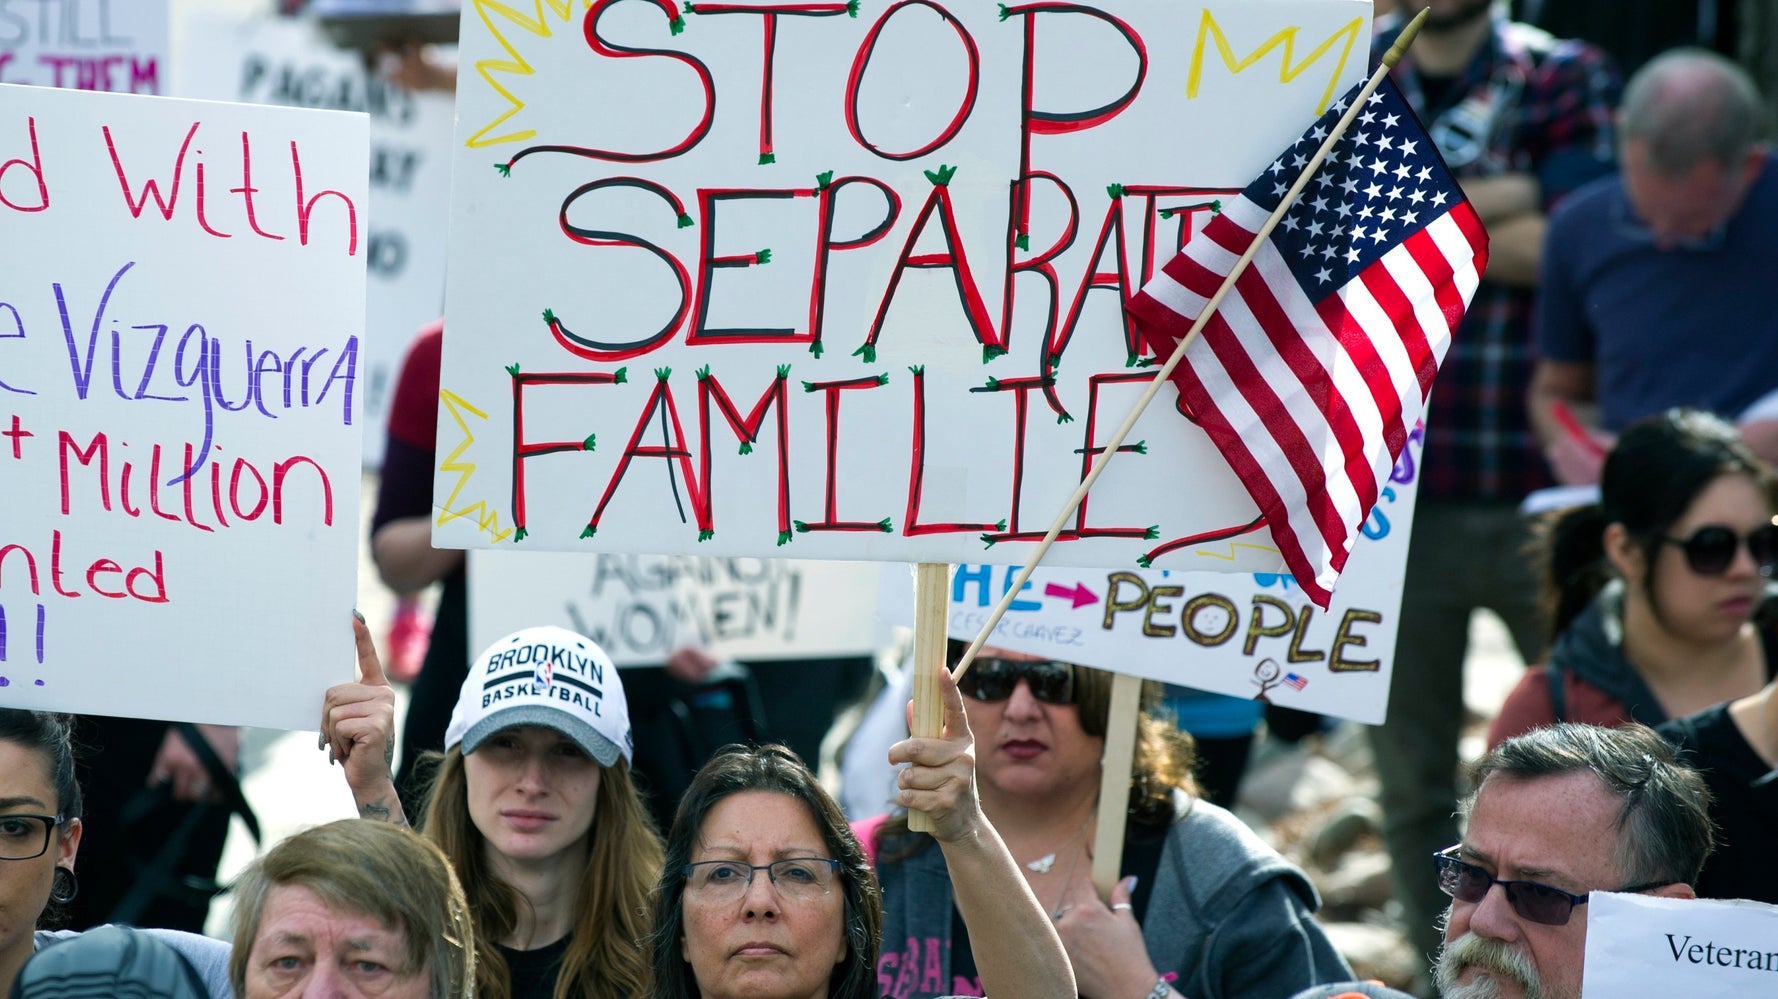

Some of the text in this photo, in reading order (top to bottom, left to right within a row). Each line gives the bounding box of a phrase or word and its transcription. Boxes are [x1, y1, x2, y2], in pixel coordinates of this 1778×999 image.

[494, 0, 1149, 251] STOP
[102, 121, 358, 256] With
[541, 164, 1246, 424] SEPARAT
[58, 431, 334, 533] Million
[505, 363, 1266, 567] FAMILIE
[486, 644, 603, 685] BROOKLYN
[1102, 571, 1383, 673] PEOPLE
[481, 682, 602, 718] BASKETBALL
